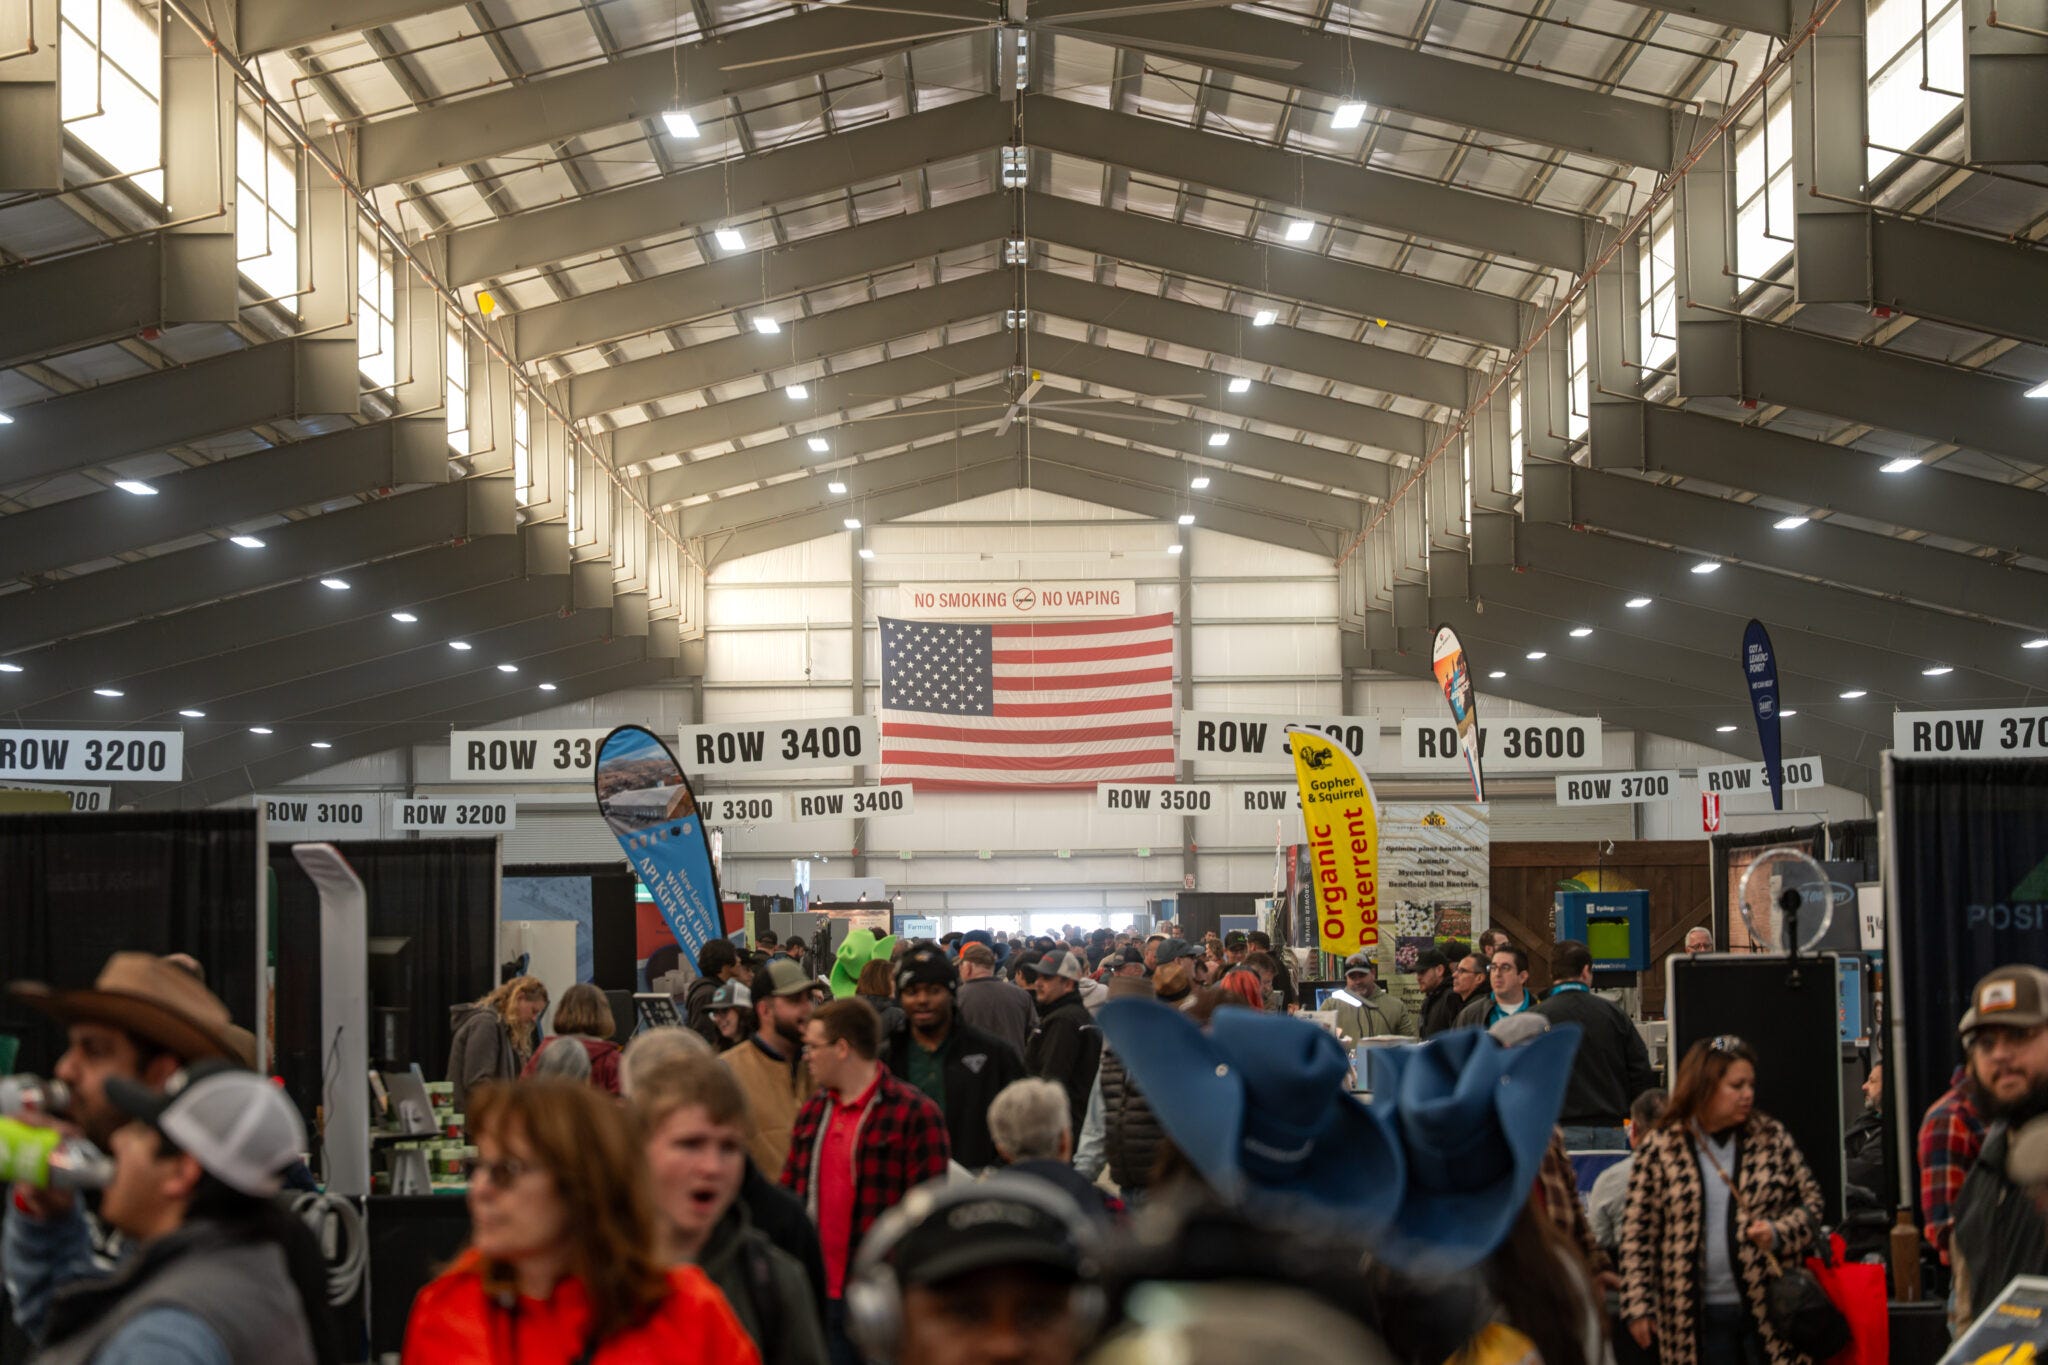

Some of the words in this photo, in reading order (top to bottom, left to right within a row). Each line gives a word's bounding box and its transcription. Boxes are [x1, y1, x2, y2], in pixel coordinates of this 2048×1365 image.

[915, 592, 935, 608] NO
[939, 592, 1007, 608] SMOKING
[1042, 591, 1063, 606] NO
[1066, 590, 1120, 607] VAPING
[696, 731, 764, 764] ROW
[782, 726, 861, 760] 3400
[1198, 721, 1267, 753] ROW
[1504, 727, 1584, 758] 3600
[1914, 720, 1983, 751] ROW
[0, 739, 69, 770] ROW
[85, 739, 165, 771] 3200
[468, 740, 537, 770] ROW
[554, 739, 599, 770] 33
[1310, 776, 1355, 792] Gopher
[1568, 780, 1611, 800] ROW
[1622, 776, 1668, 798] 3700
[1709, 769, 1750, 790] ROW
[801, 795, 843, 815] ROW
[854, 791, 903, 812] 3400
[1108, 790, 1150, 809] ROW
[1161, 790, 1210, 810] 3500
[1245, 791, 1286, 810] ROW
[1308, 793, 1316, 803] &
[1318, 788, 1363, 804] Squirrel
[265, 802, 307, 821] ROW
[318, 804, 362, 823] 3100
[404, 805, 446, 824] ROW
[456, 805, 505, 824] 3200
[723, 799, 772, 820] 3300
[1424, 817, 1446, 826] NRG
[640, 857, 660, 884] API
[655, 881, 677, 917] Kirk
[1311, 823, 1348, 940] Organic
[1343, 806, 1379, 946] Deterrent
[666, 870, 695, 922] Willard,
[679, 868, 693, 891] New
[690, 890, 714, 931] Location
[1967, 904, 2048, 930] POSI
